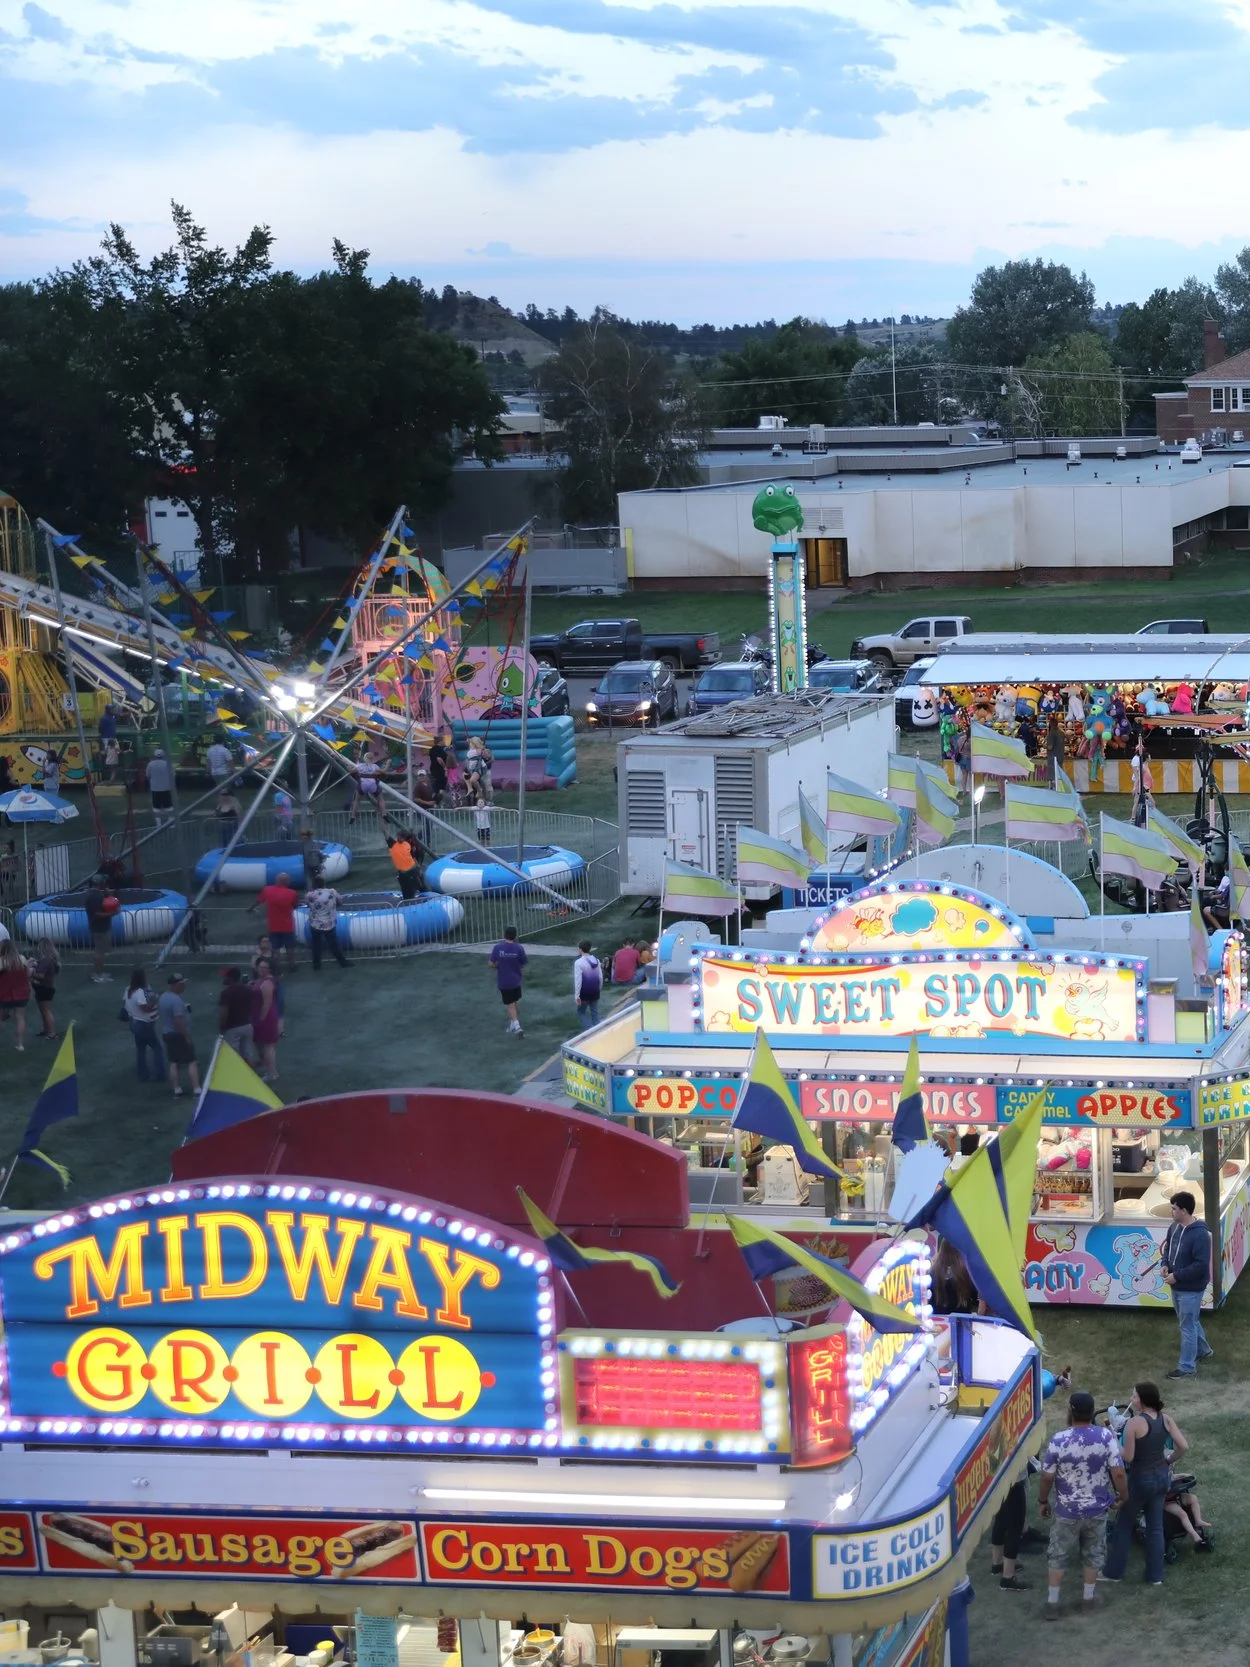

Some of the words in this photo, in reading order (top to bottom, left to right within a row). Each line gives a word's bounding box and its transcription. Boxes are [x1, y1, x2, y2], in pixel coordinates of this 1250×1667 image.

[798, 887, 849, 903] TICKETS
[736, 973, 901, 1025] SWEET
[924, 970, 1048, 1021] SPOT
[566, 1079, 606, 1108] DRINKS
[634, 1084, 738, 1111] POPCO
[1008, 1091, 1056, 1104] CAY
[1077, 1094, 1182, 1120] APPLES
[1202, 1086, 1233, 1105] ICE
[33, 1210, 501, 1330] MIDWAY
[1023, 1261, 1085, 1292] ALTY
[76, 1338, 464, 1411] GRILL
[808, 1349, 834, 1445] GRILL
[112, 1521, 356, 1577] Sausage
[431, 1528, 570, 1575] Corn
[586, 1533, 731, 1590] Dogs
[828, 1539, 879, 1566] ICE
[890, 1511, 945, 1556] COLD
[843, 1541, 940, 1590] DRINKS
